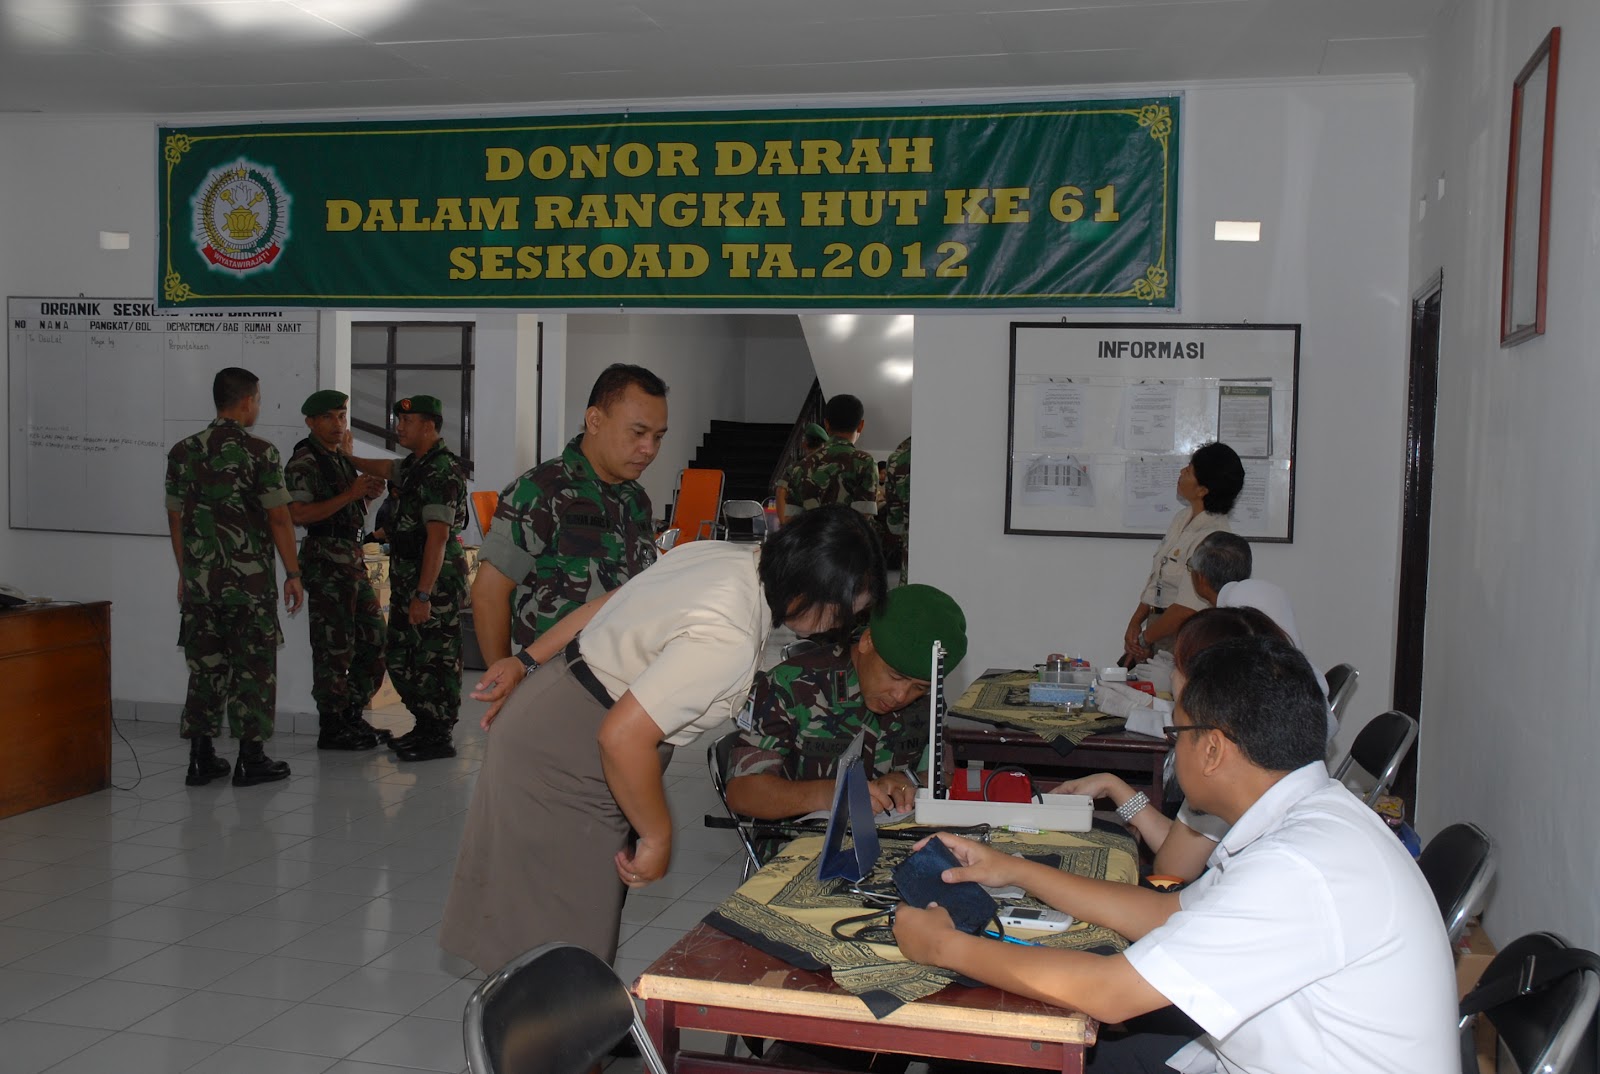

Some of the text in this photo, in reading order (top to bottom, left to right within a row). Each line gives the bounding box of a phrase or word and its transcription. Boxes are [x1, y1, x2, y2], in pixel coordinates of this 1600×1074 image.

[485, 137, 934, 181] DONOR DARAH
[325, 184, 1120, 232] DALAM RANGKA HUT KE 61
[213, 250, 270, 268] WIYATAWIRAJATI
[449, 243, 710, 280] SESKOAD
[40, 302, 101, 316] ORGANIK
[113, 303, 180, 317] SESK
[14, 320, 26, 329] NO
[244, 323, 302, 333] RUMAH SAKIT
[1098, 340, 1205, 360] INFORMASI
